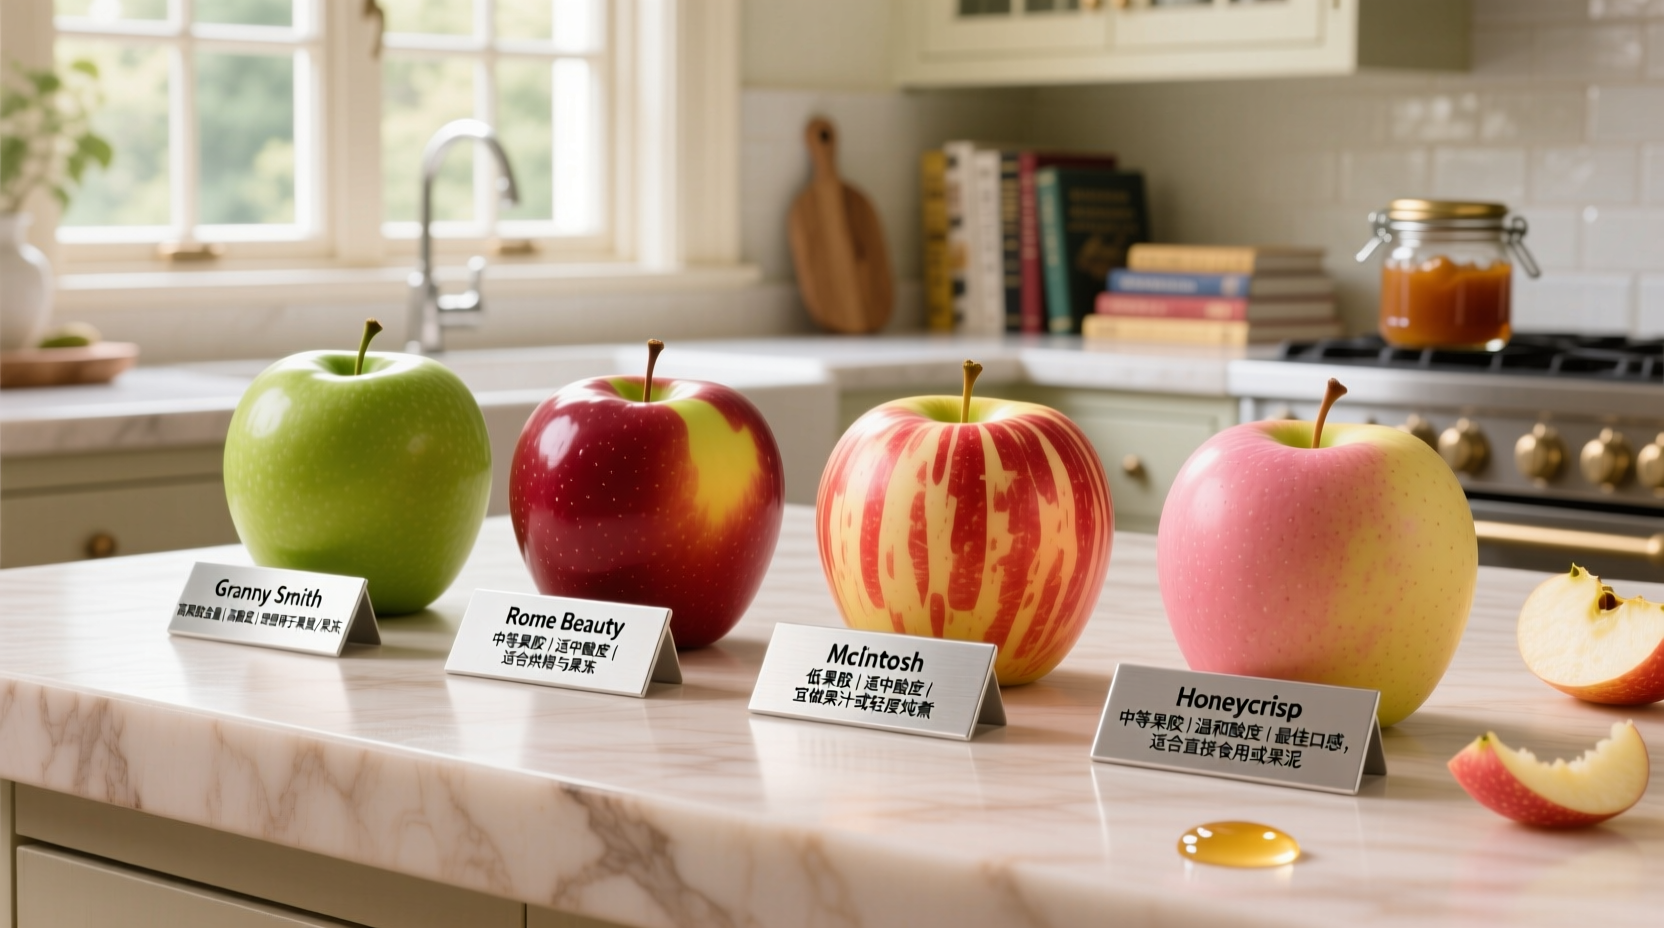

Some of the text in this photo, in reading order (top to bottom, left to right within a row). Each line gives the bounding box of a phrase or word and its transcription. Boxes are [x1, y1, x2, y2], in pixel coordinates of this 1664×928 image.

[215, 578, 323, 609] Granny Smith
[505, 606, 626, 641] Rome Beauty
[826, 642, 924, 673] McIntosh
[1119, 708, 1185, 733] 中等果胶
[1176, 686, 1303, 723] Honeycrisp
[1149, 732, 1302, 769] 适合直接食用或果泥
